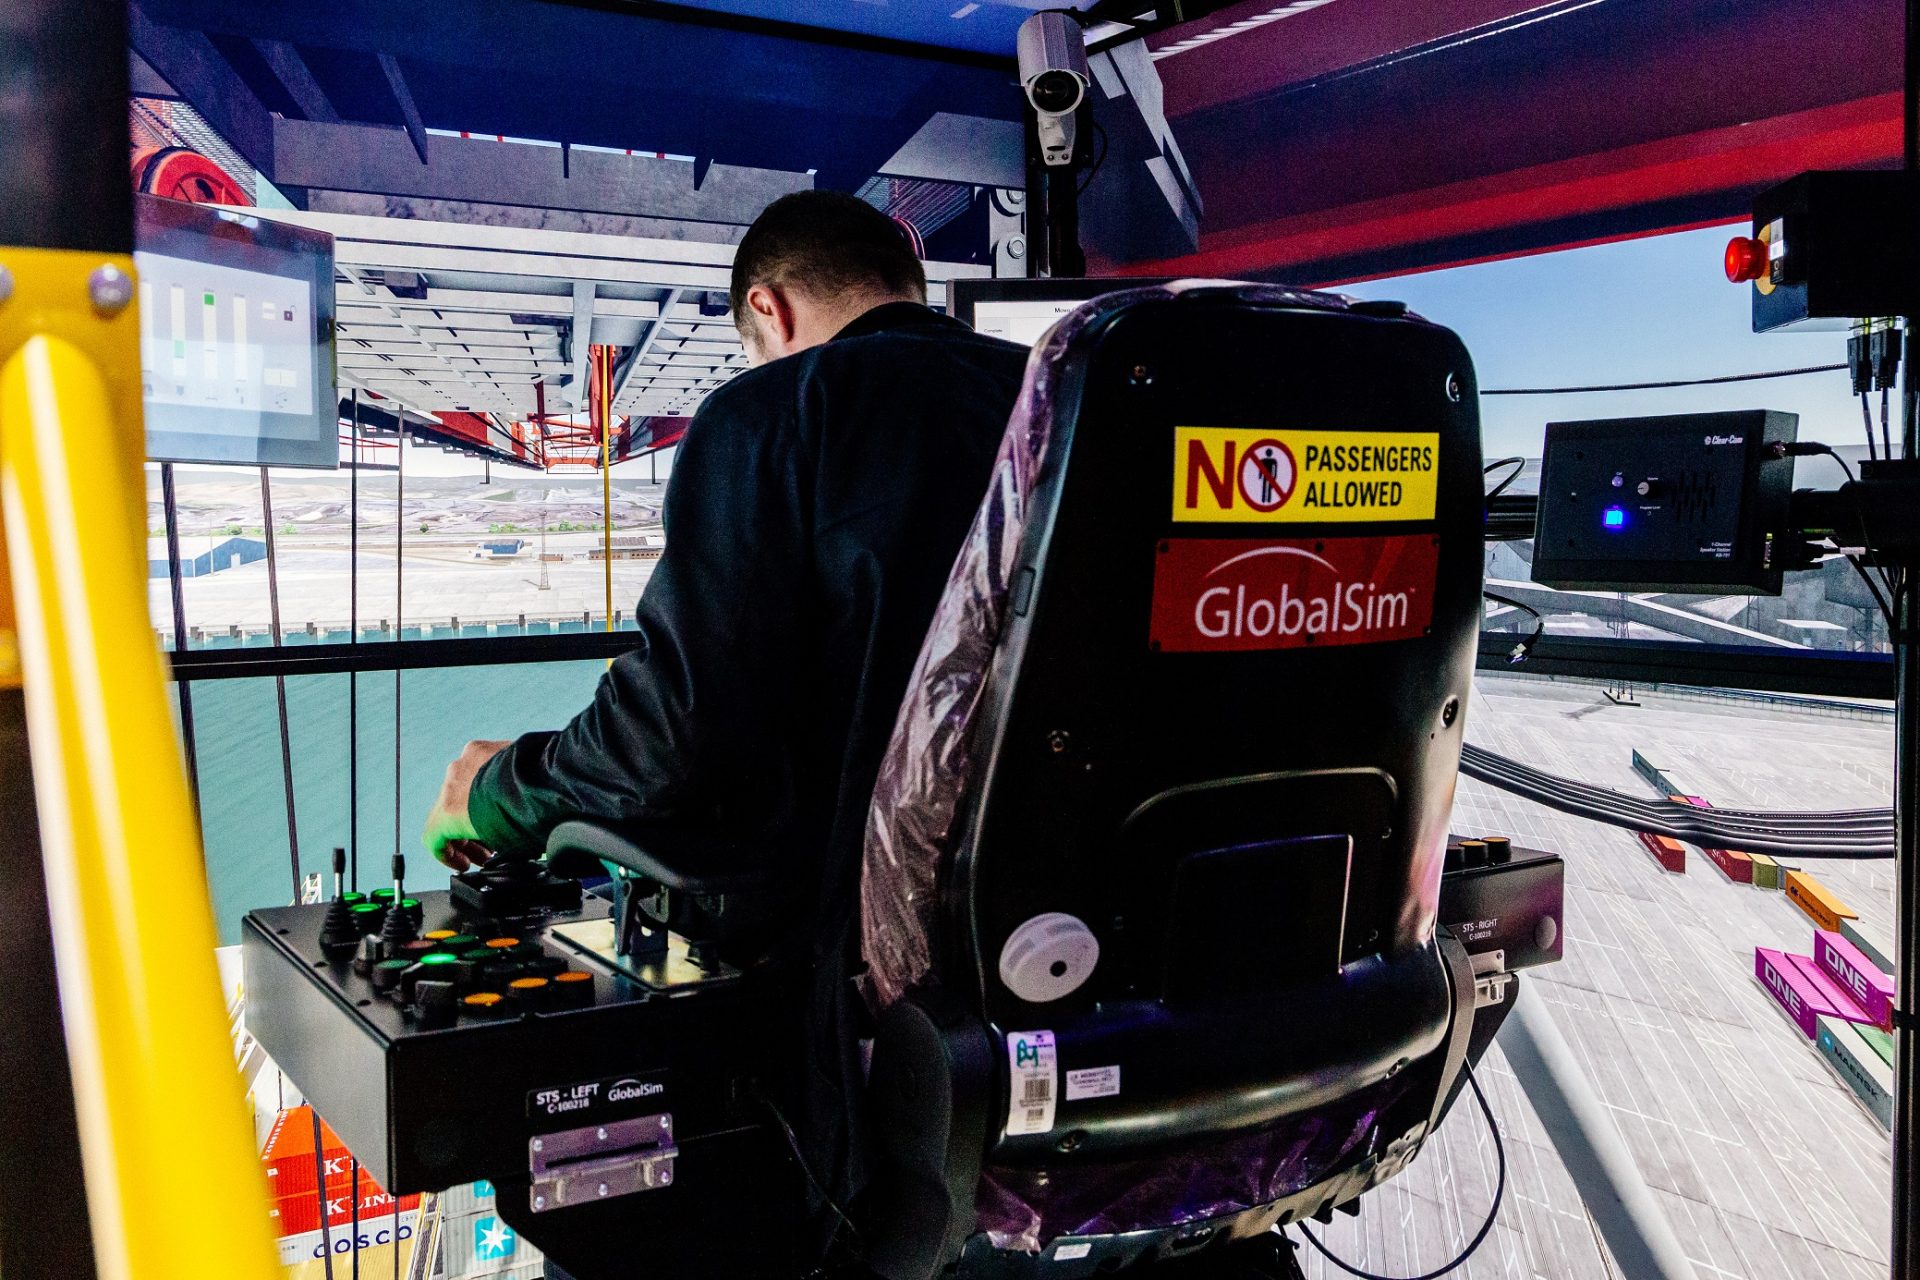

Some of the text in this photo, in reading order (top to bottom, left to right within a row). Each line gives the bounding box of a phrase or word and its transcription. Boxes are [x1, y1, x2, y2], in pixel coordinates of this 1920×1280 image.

[1305, 445, 1433, 472] PASSENGERS
[1303, 481, 1403, 508] ALLOWED
[1195, 582, 1409, 638] GlobalSim
[1462, 922, 1474, 933] STS
[1479, 918, 1498, 930] RIGHT
[1825, 944, 1867, 999] ONE
[1765, 961, 1801, 1016] ONE
[536, 1089, 560, 1106] STS
[571, 1083, 600, 1100] LEFT
[608, 1083, 664, 1102] GlobalSim
[313, 1225, 413, 1259] COSCO
